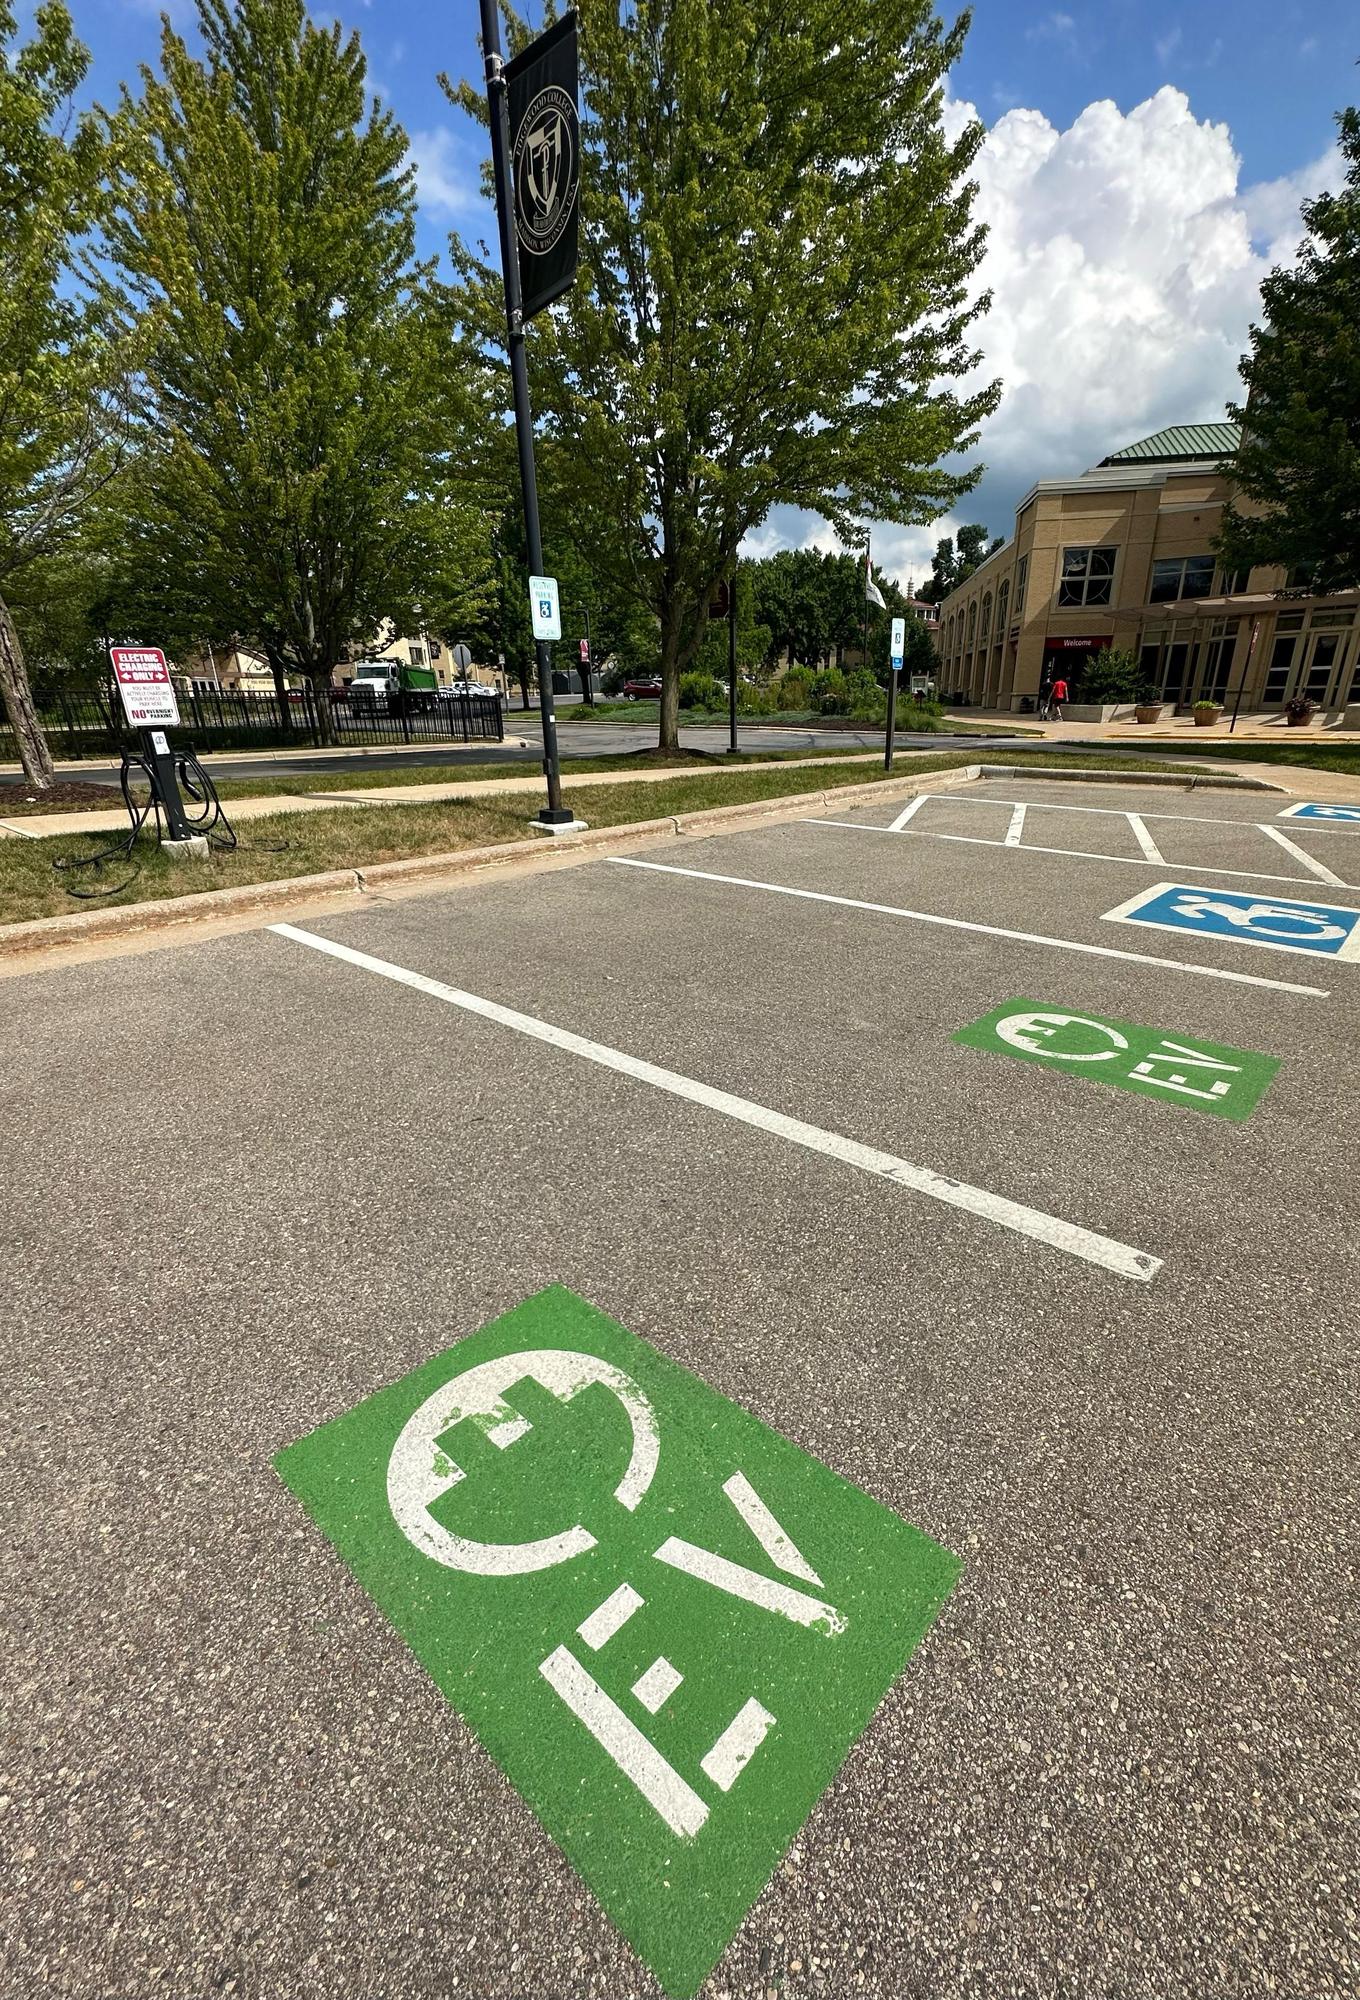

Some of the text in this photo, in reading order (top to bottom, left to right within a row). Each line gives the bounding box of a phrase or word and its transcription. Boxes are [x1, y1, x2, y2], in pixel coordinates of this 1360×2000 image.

[516, 91, 573, 156] EDGEWOOD COLLEGE
[118, 653, 159, 663] ELECTRIC
[118, 662, 164, 672] CHARGING
[132, 671, 154, 681] ONLY
[131, 709, 147, 719] NO
[1127, 1040, 1243, 1100] EV
[538, 1470, 849, 1838] EV
